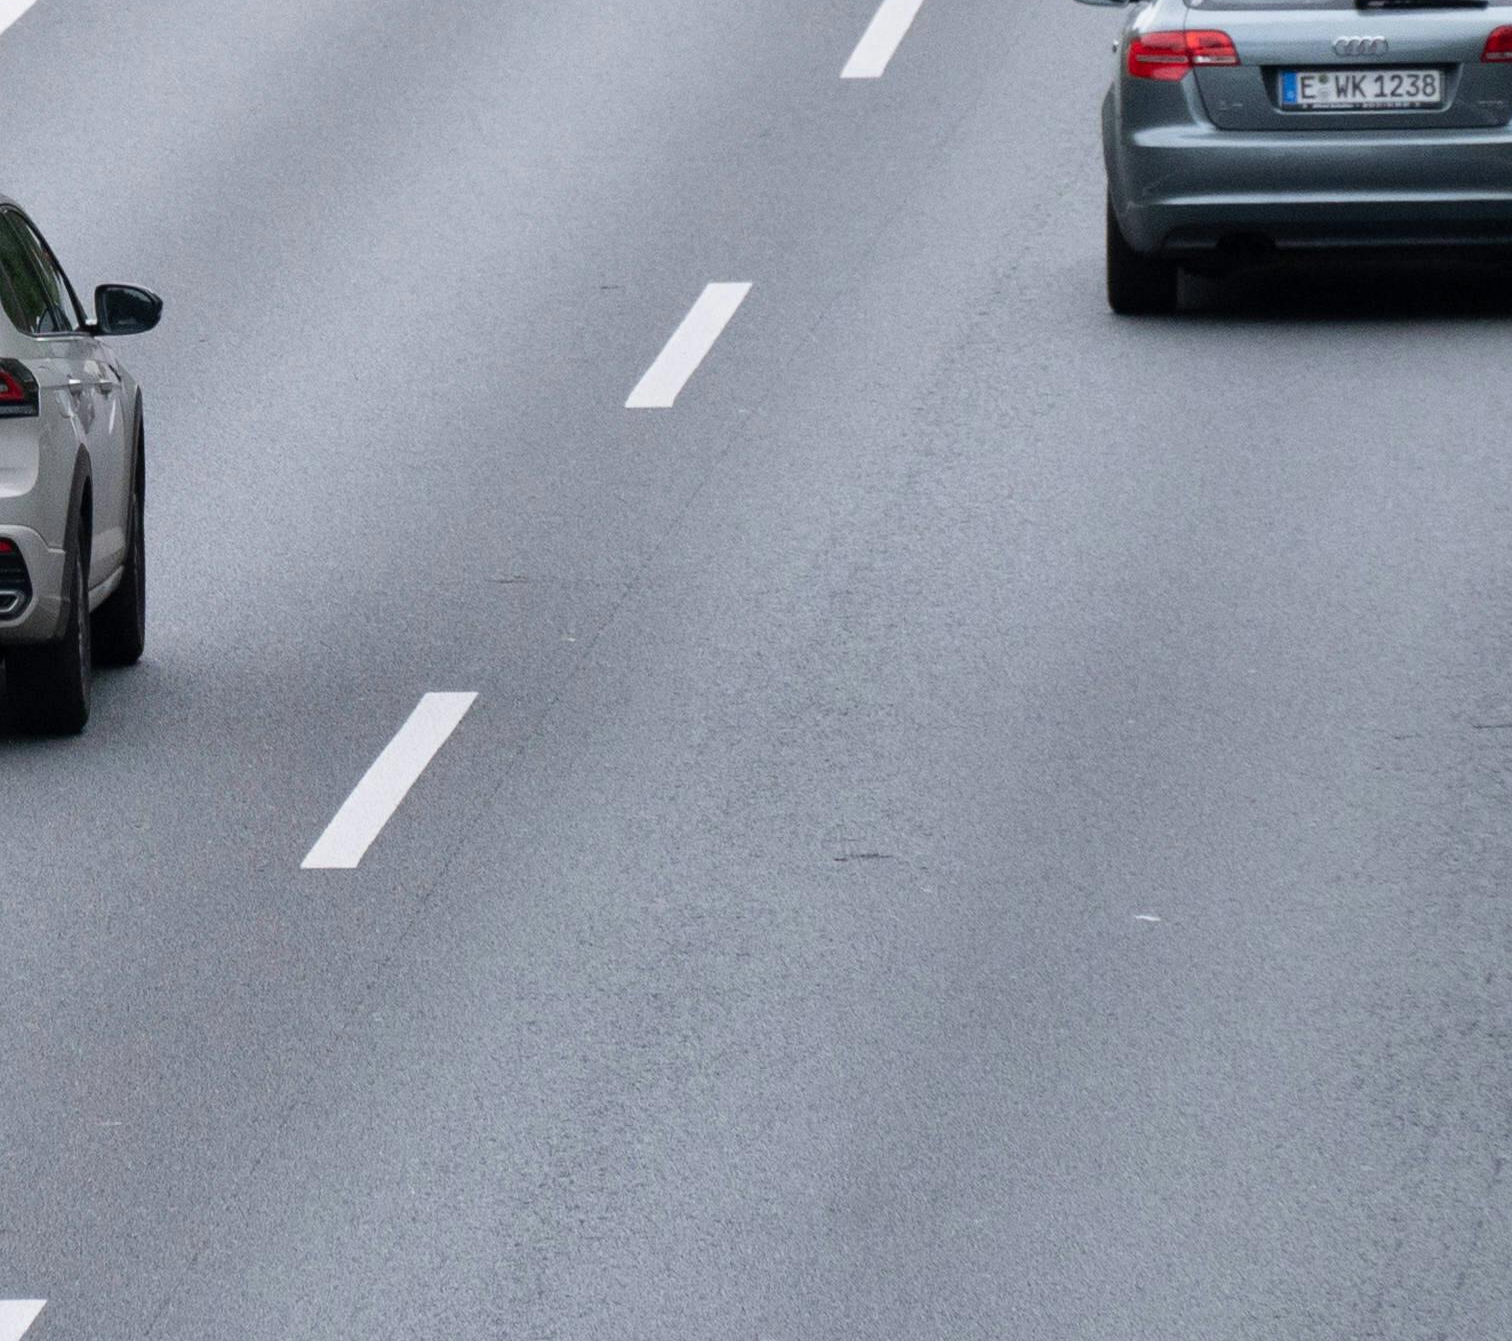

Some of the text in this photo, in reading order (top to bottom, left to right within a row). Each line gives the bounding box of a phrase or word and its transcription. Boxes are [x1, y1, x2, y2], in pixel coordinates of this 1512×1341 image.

[1300, 74, 1437, 99] E WK 1238
